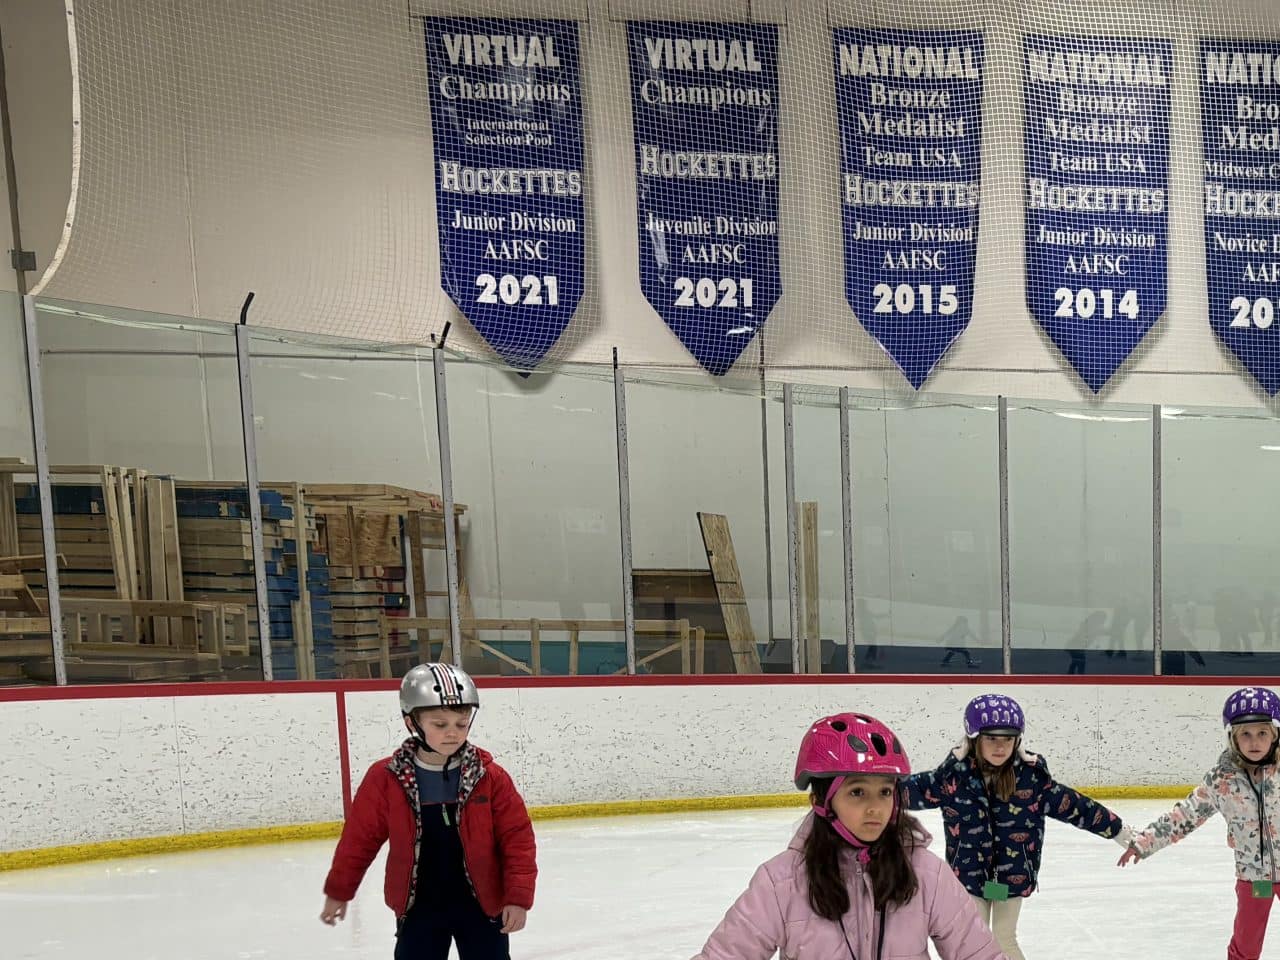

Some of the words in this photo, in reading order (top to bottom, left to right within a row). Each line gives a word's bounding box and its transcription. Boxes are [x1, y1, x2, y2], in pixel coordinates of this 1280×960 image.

[443, 34, 560, 67] VIRTUAL
[645, 38, 762, 71] VIRTUAL
[840, 44, 979, 79] NATIONAL
[1029, 52, 1165, 85] NATIONAL
[440, 76, 571, 106] Champions
[641, 79, 771, 110] Champions
[871, 84, 950, 108] Bronze
[1060, 88, 1138, 113] Bronze
[467, 119, 549, 131] International
[857, 114, 966, 137] Medalist
[1045, 119, 1152, 143] Medalist
[465, 133, 522, 145] Selection
[526, 134, 552, 146] Pool
[640, 144, 776, 179] HOCKETTES
[863, 148, 912, 167] Team
[920, 149, 961, 168] USA
[1050, 152, 1097, 171] Team
[1105, 153, 1146, 172] USA
[1204, 162, 1264, 178] Midwest
[441, 161, 582, 195] HOCKETTES
[845, 175, 980, 208] HOCKETTES
[1028, 178, 1163, 212] HOCKETTES
[452, 210, 504, 231] Junior
[511, 211, 576, 233] Division
[645, 214, 711, 234] Juvenile
[716, 215, 776, 235] Division
[852, 222, 904, 241] Junior
[910, 222, 973, 242] Division
[1036, 225, 1088, 245] Junior
[1094, 226, 1155, 247] Division
[1214, 232, 1268, 253] Novice
[484, 240, 549, 260] AAFSC
[682, 244, 746, 263] AAFSC
[881, 251, 946, 271] AAFSC
[1064, 255, 1129, 275] AAFSC
[476, 274, 557, 305] 2021
[673, 278, 752, 308] 2021
[872, 283, 958, 314] 2015
[1054, 287, 1139, 319] 2014
